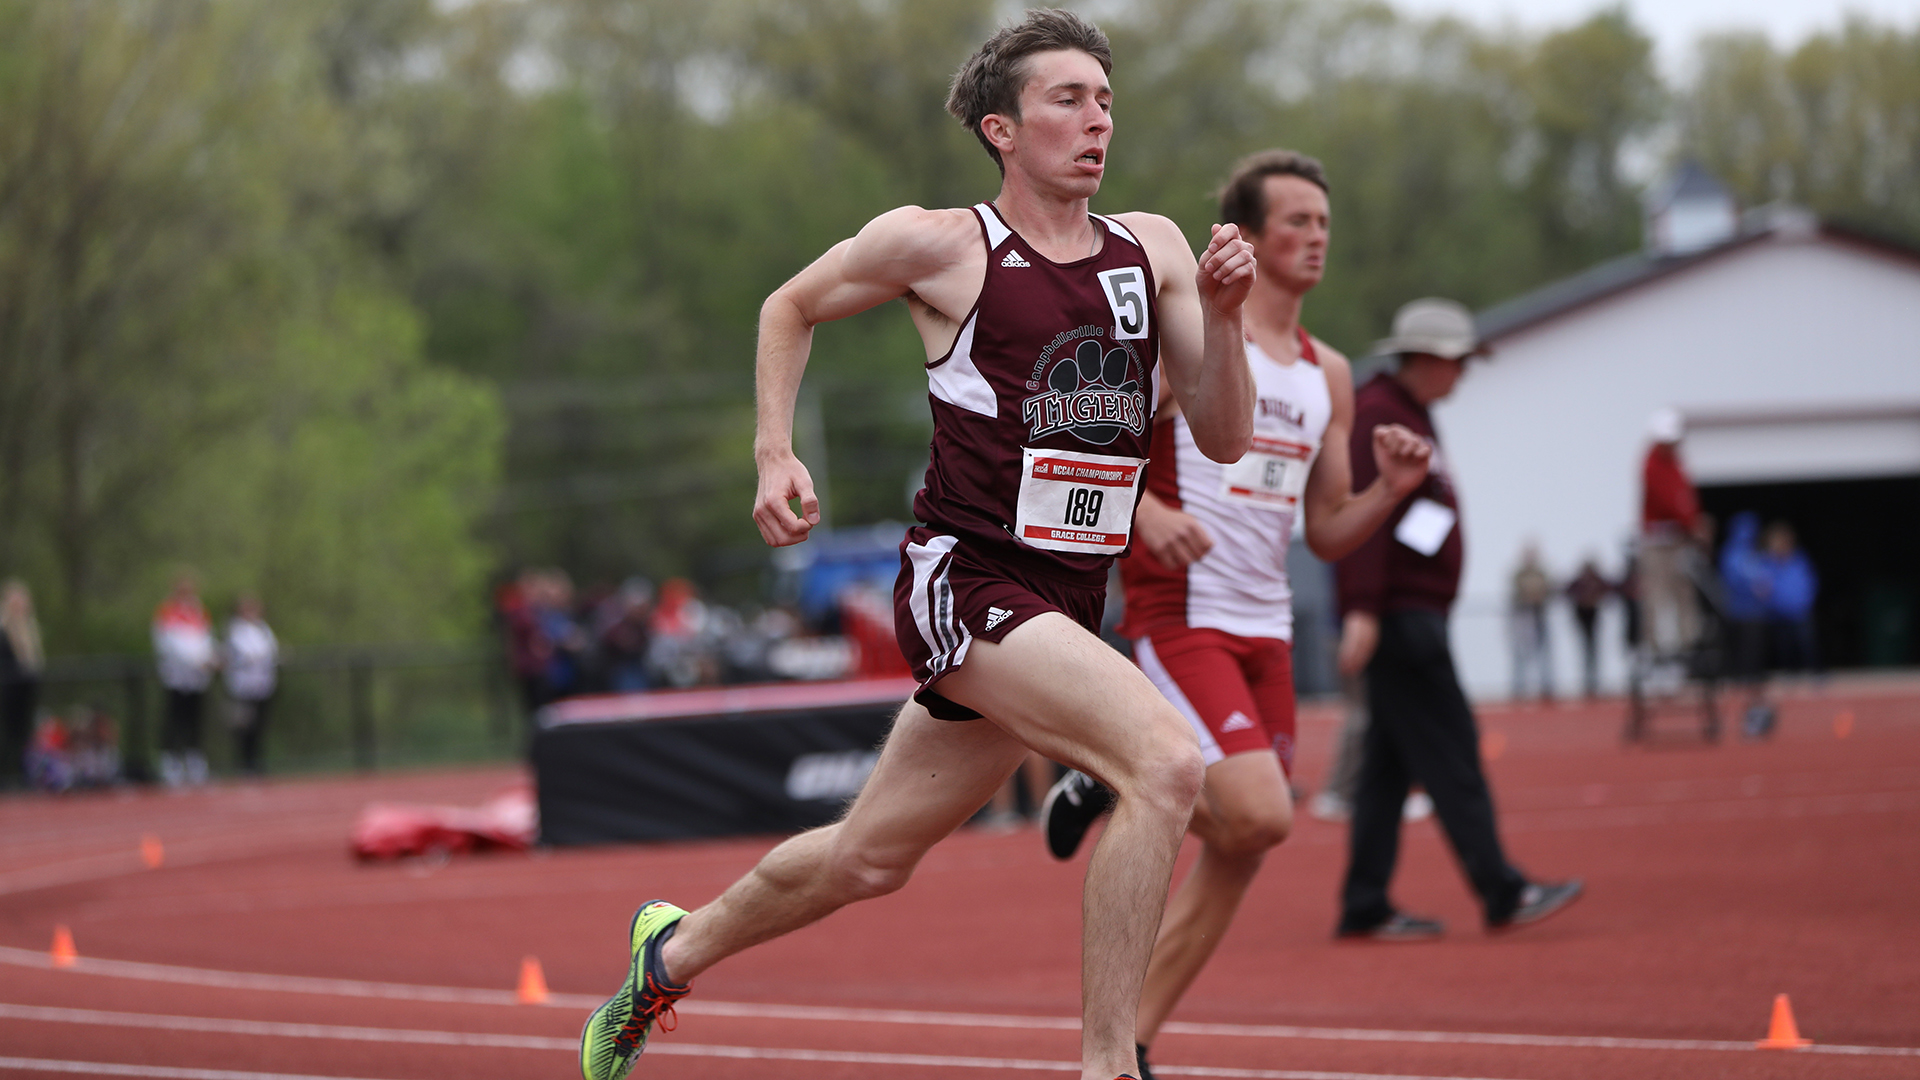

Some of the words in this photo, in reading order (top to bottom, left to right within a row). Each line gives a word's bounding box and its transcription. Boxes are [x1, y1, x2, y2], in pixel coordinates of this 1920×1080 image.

[1108, 273, 1143, 335] 5
[1025, 325, 1104, 391] Campbellsville
[1022, 389, 1146, 442] TIGERS
[1052, 464, 1075, 477] NCCAA
[1075, 467, 1123, 481] CHAMPIONSHIPS
[1064, 487, 1104, 527] 189
[1051, 529, 1075, 540] GRACE
[1076, 532, 1106, 543] COLLEGE
[985, 609, 1014, 632] adidas
